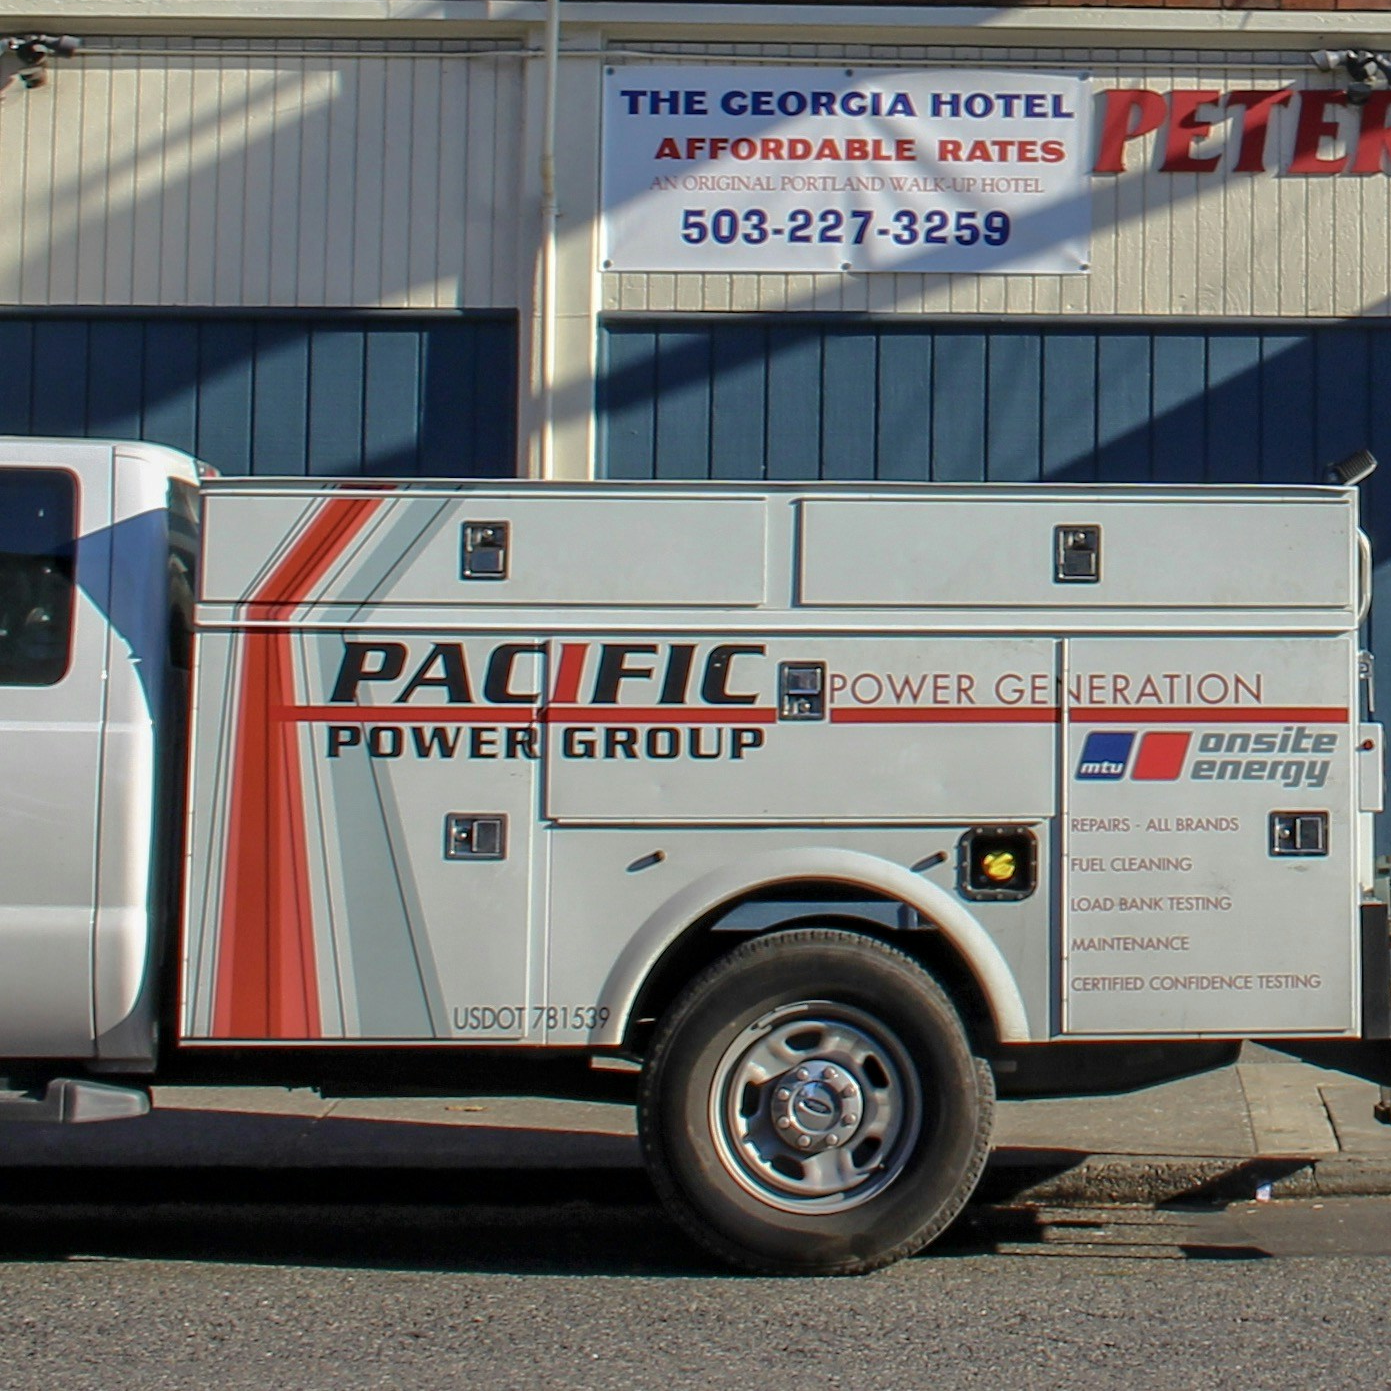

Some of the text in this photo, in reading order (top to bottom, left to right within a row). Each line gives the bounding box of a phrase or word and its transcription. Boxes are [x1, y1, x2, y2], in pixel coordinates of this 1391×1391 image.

[620, 90, 1075, 120] THE GEORGIA HOTEL
[654, 137, 1067, 164] AFFORDABLE RATES
[649, 176, 1045, 194] AN ORIGINAL PORTLAND WALK-UP HOTEL
[681, 209, 1011, 245] 503-227-3259
[329, 642, 767, 704] PACIFIC
[830, 672, 1262, 705] POWER GENERATION
[327, 726, 765, 759] POWER GROUP
[1198, 727, 1338, 754] onsite
[1079, 760, 1124, 775] mtu
[1190, 759, 1331, 789] energy
[1071, 818, 1131, 832] REPAIRS
[1145, 817, 1171, 832] ALL
[1176, 817, 1239, 832] BRANDS
[1071, 857, 1193, 872] FUEL CLEANING
[1071, 896, 1232, 912] LOAD BANK TESTING
[1071, 936, 1190, 951] MAINTENANCE
[1071, 974, 1322, 991] CERTIFIED CONFIDENCE TESTING
[453, 1006, 611, 1030] USDOT 781539
